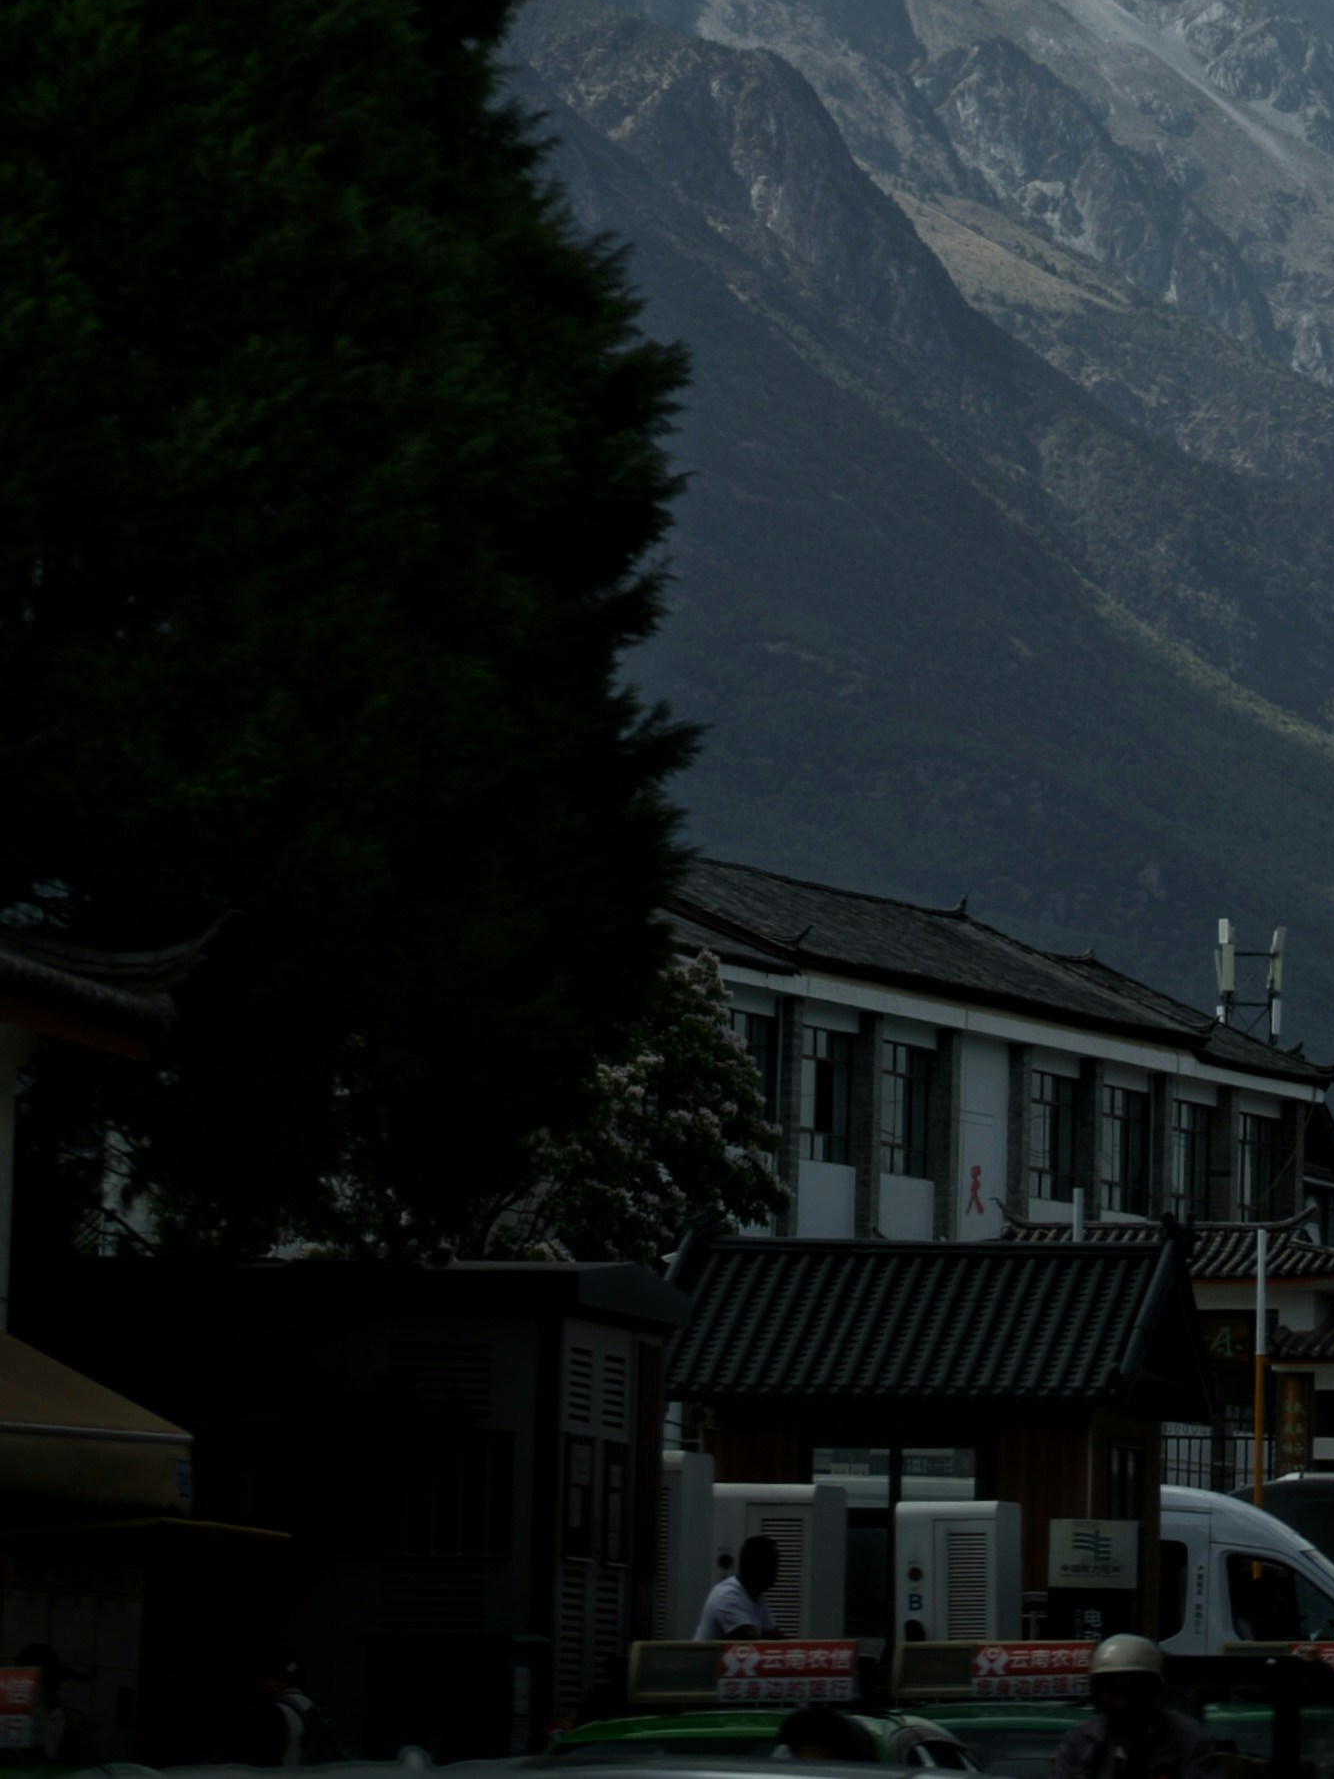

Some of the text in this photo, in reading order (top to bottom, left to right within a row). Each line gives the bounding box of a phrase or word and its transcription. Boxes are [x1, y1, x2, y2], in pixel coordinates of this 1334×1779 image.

[909, 1594, 922, 1610] B
[761, 1648, 854, 1670] 云南农信
[1008, 1647, 1092, 1669] 云南农信
[722, 1678, 850, 1701] 您身边的银行
[976, 1675, 1089, 1697] 您身边的银行
